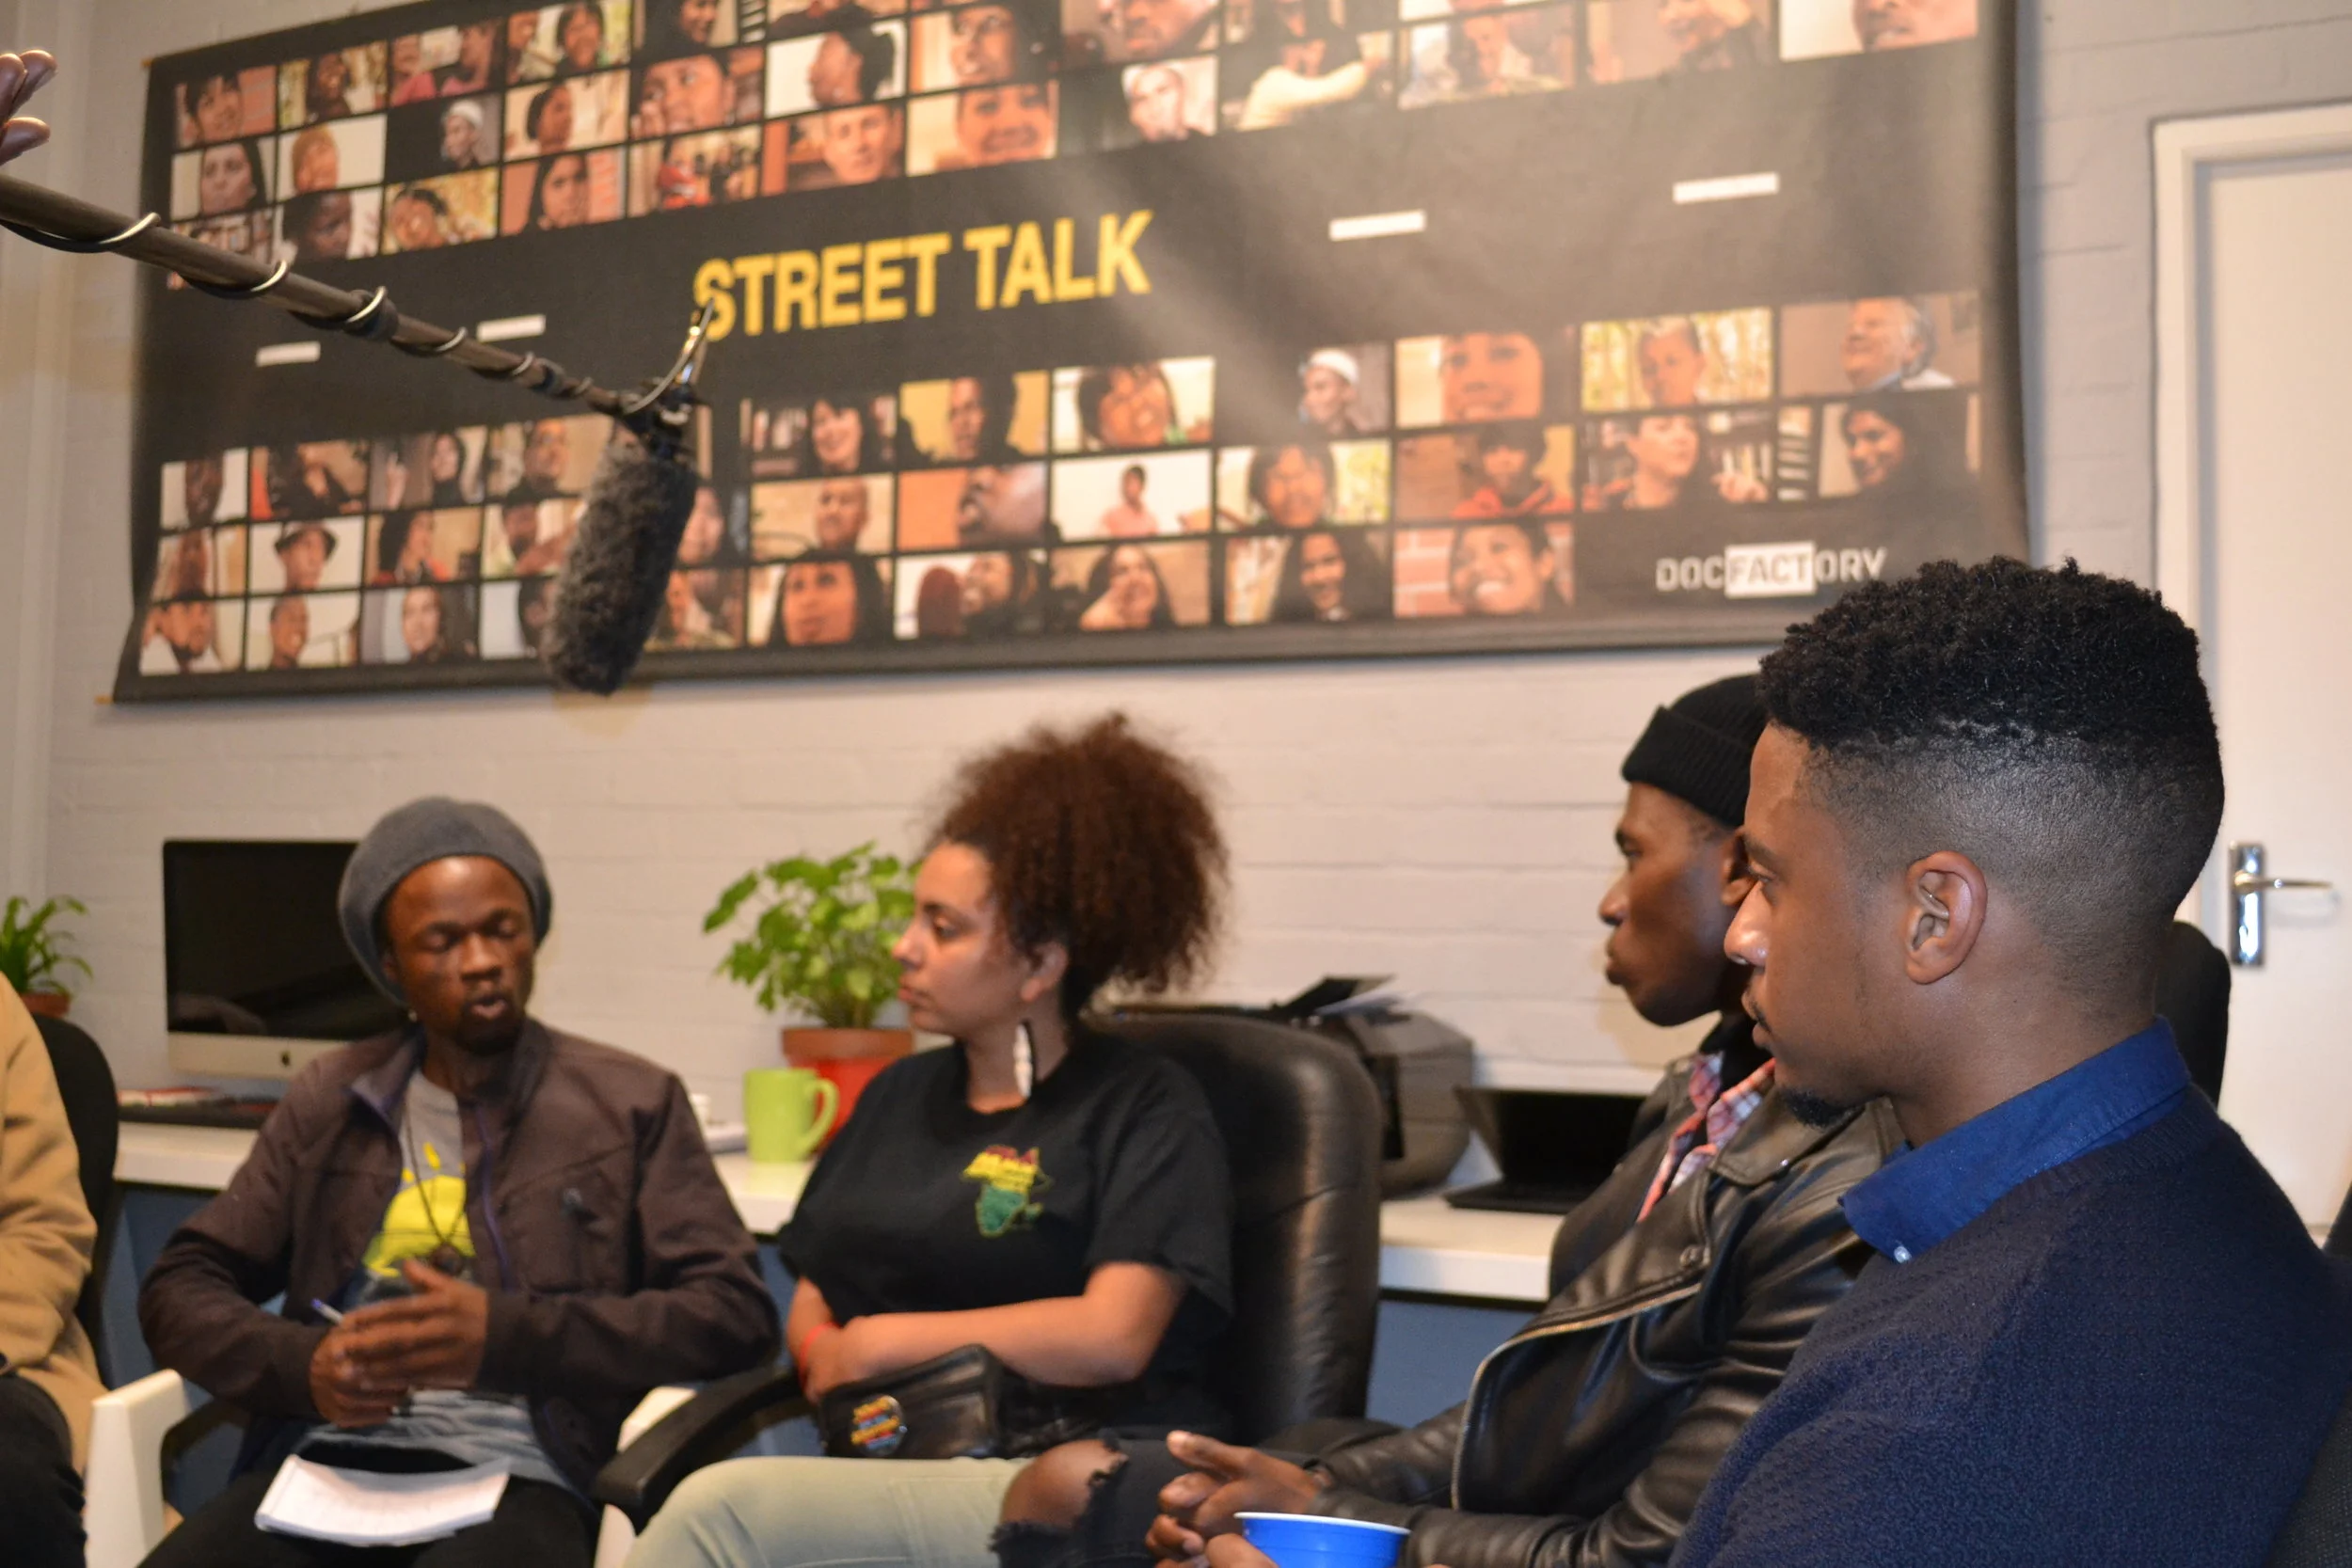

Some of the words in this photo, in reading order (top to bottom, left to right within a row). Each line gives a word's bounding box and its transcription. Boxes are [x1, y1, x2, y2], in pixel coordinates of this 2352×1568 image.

[693, 231, 951, 342] STREET
[962, 209, 1153, 310] TALK
[1655, 544, 1886, 594] DOCFACTORY
